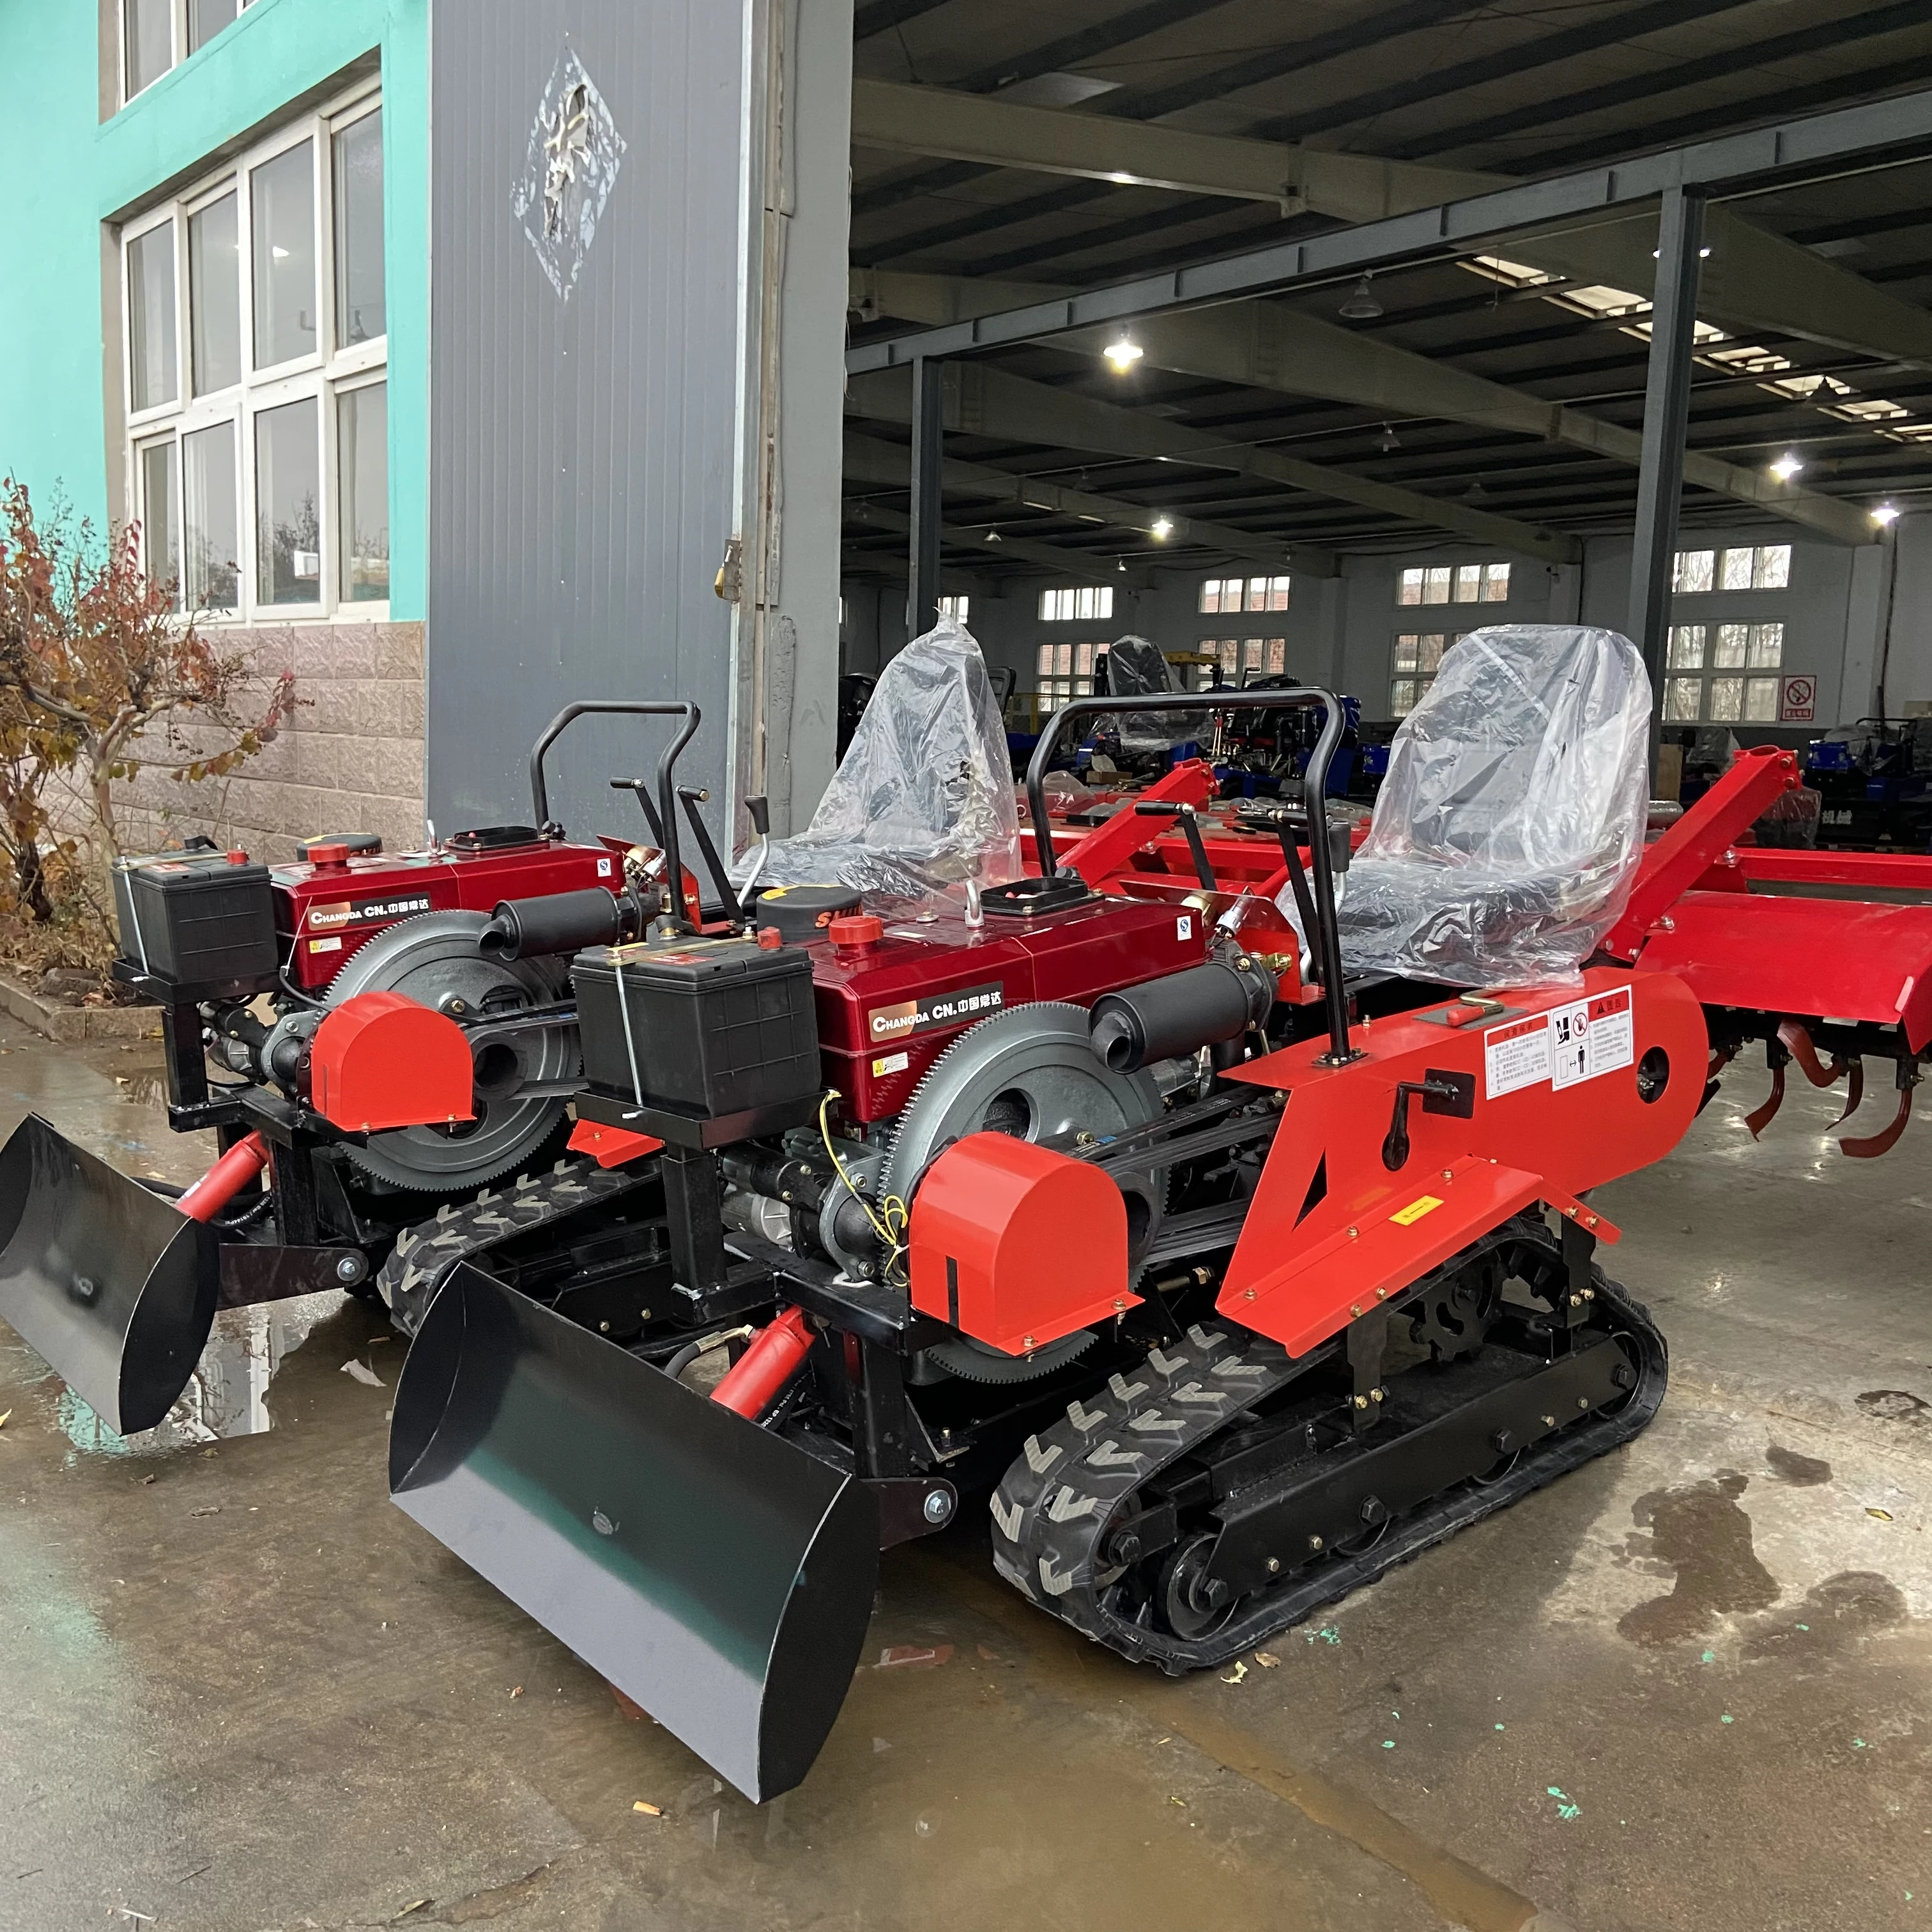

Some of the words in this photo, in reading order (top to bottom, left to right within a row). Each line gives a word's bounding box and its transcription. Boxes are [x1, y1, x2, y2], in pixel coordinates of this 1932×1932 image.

[310, 910, 362, 924] CHANGDA
[873, 1012, 930, 1032] CHANGDA
[958, 991, 1002, 1013] 中国常达
